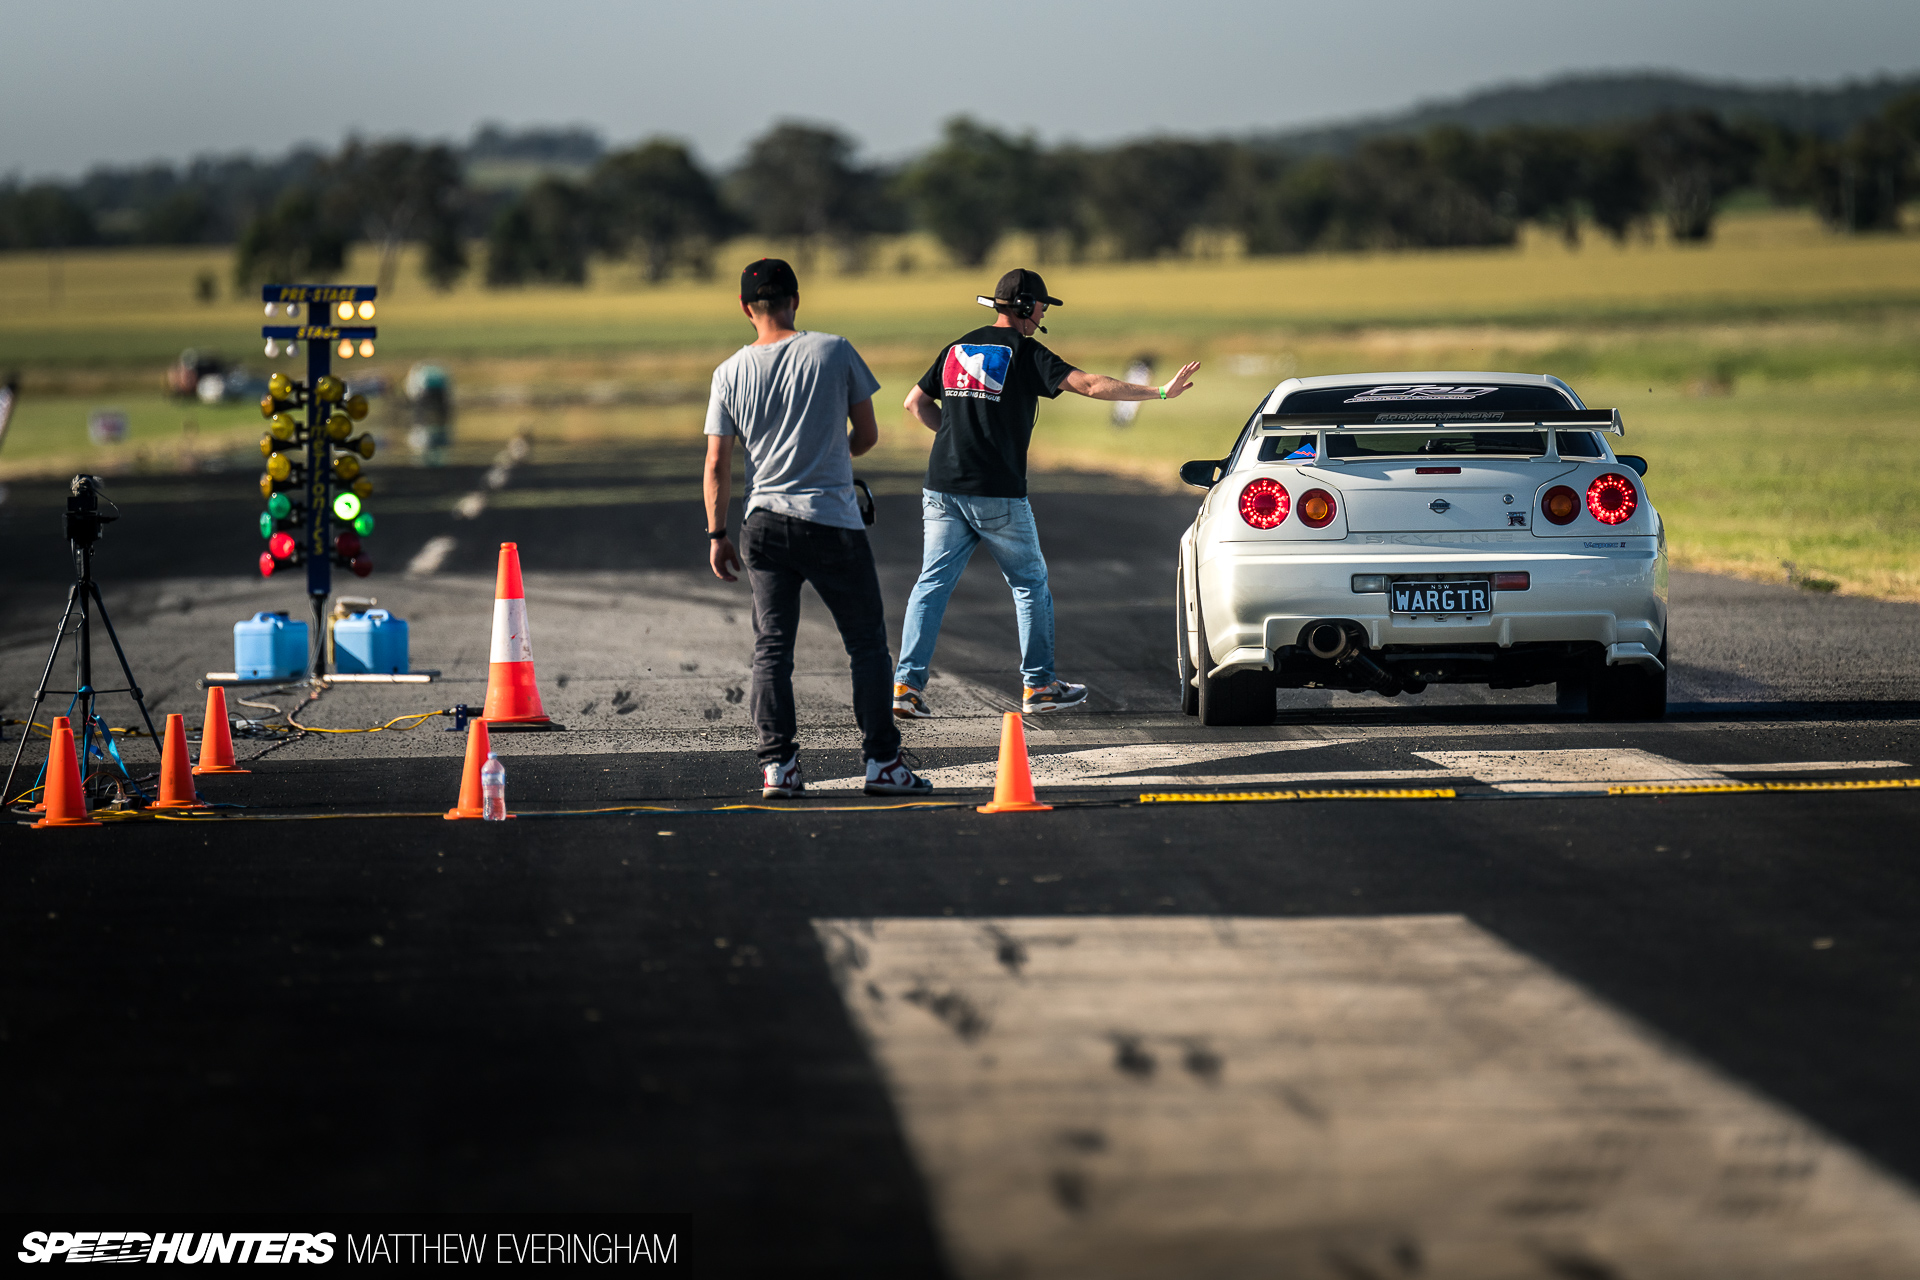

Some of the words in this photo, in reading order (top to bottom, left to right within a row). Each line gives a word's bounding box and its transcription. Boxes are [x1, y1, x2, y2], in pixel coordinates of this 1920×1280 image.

[280, 287, 357, 302] PRE-STAGE
[979, 392, 1001, 402] LEAGUE
[1448, 412, 1503, 422] RACING
[1365, 533, 1514, 545] SKYLINE
[1395, 589, 1486, 611] WARGTR
